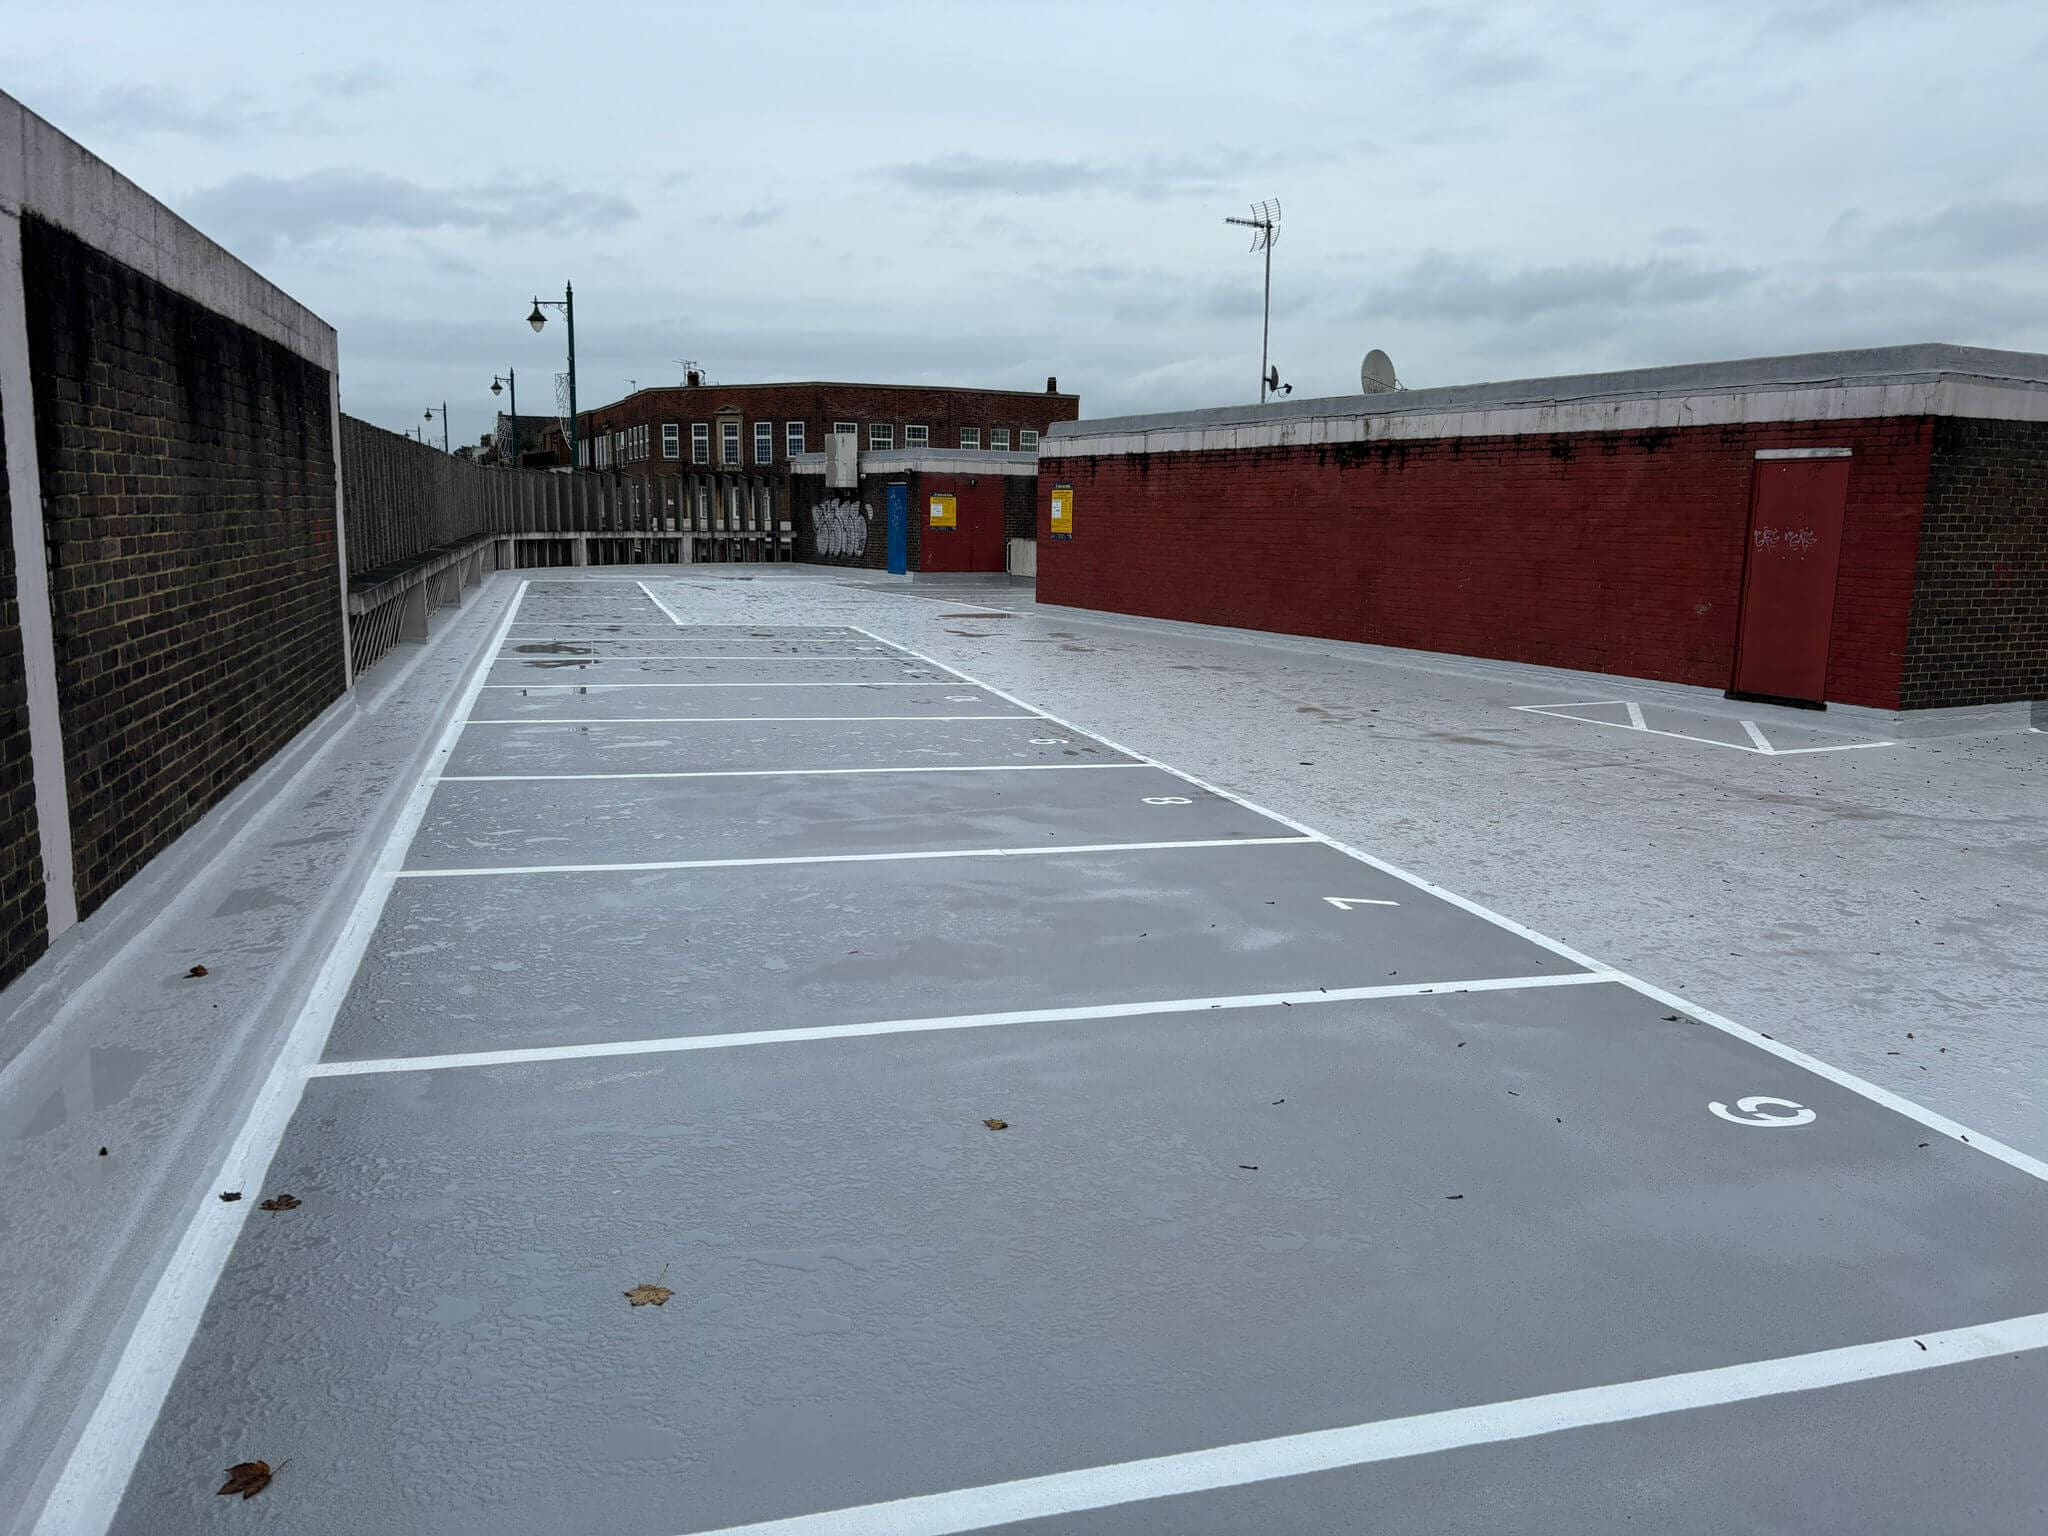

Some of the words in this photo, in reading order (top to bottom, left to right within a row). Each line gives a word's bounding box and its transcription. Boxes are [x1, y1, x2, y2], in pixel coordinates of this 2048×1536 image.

[1142, 796, 1193, 805] 8
[1322, 896, 1400, 911] 7
[1708, 1096, 1817, 1127] 6
